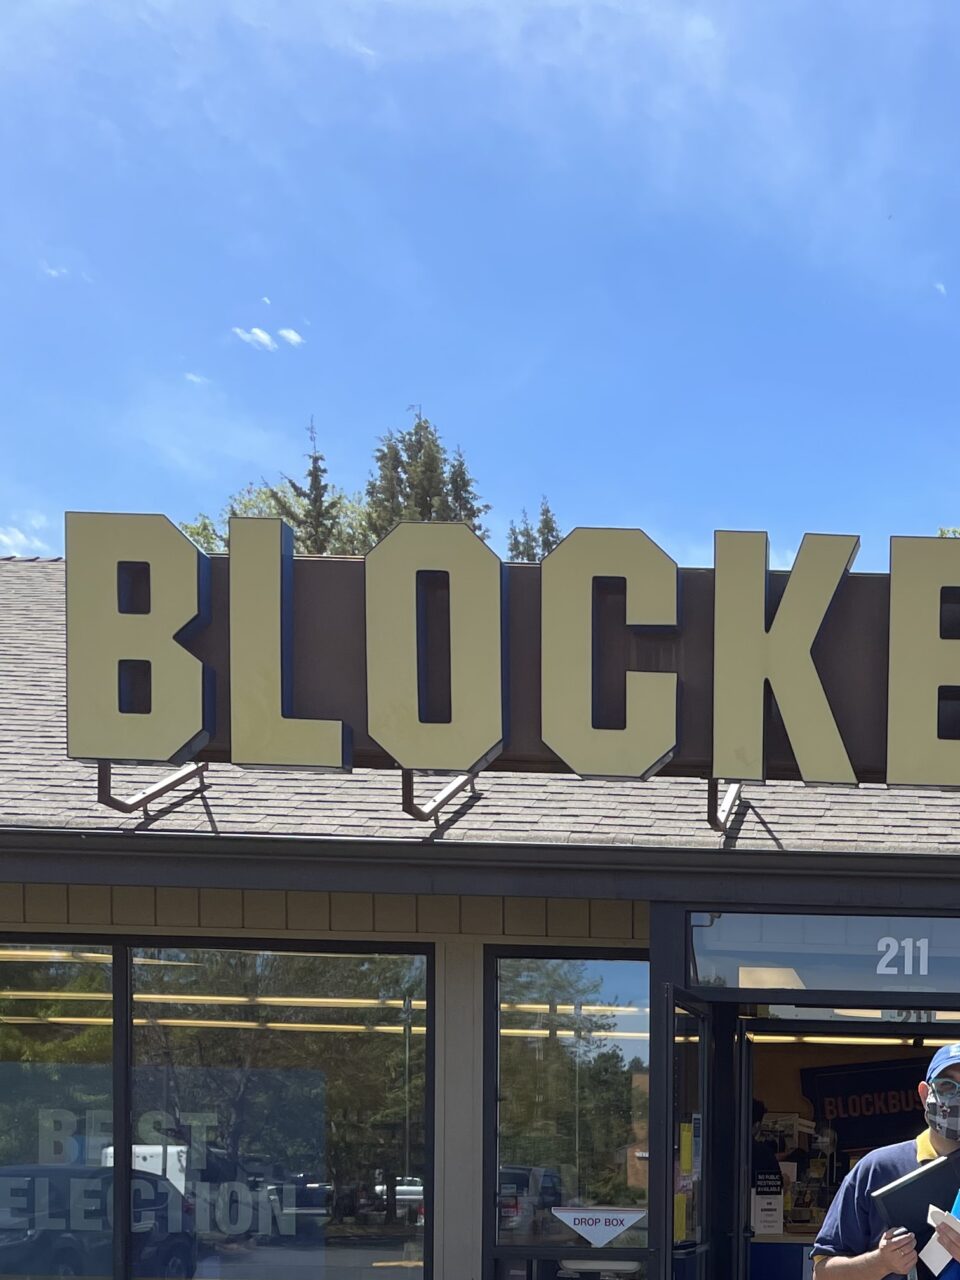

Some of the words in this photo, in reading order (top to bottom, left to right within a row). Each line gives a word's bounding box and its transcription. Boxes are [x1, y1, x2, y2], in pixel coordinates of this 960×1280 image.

[876, 936, 929, 975] 211
[824, 1089, 924, 1120] BLOCKBUS
[38, 1108, 217, 1169] BEST
[0, 1176, 296, 1236] ELECTION
[573, 1217, 601, 1227] DROP
[604, 1218, 625, 1227] BOX
